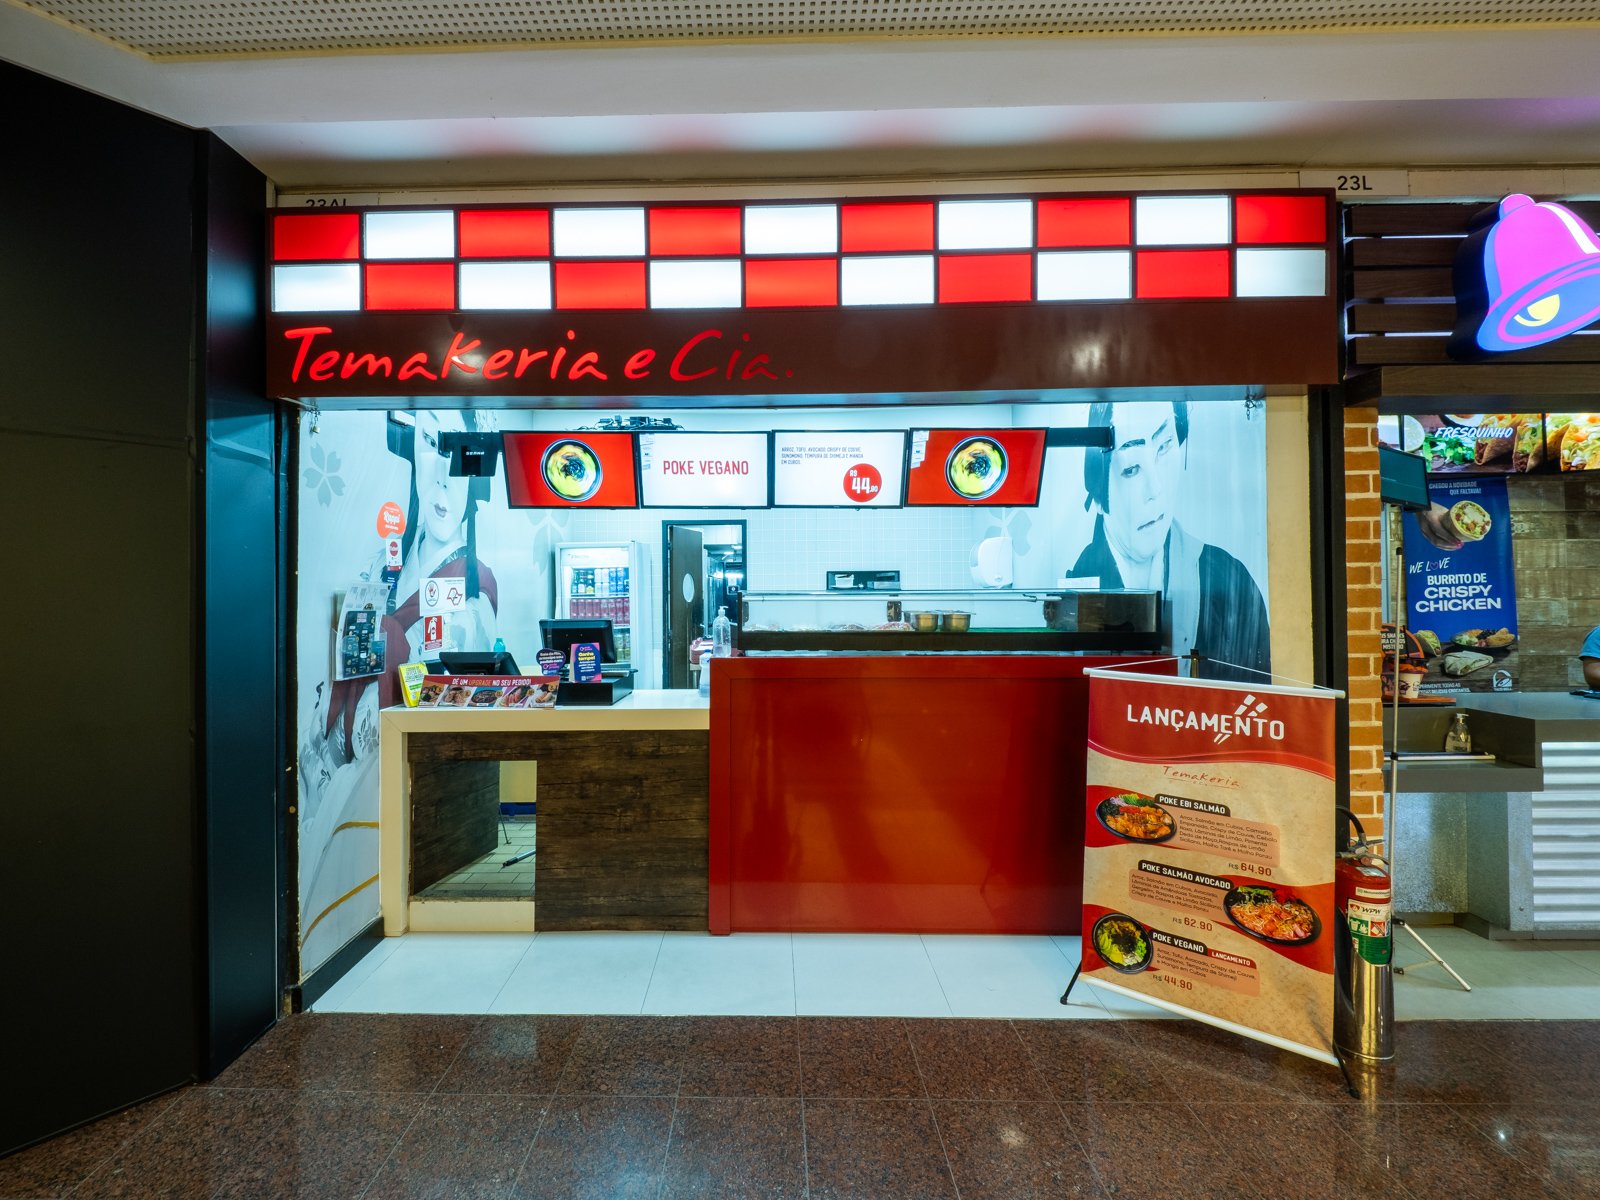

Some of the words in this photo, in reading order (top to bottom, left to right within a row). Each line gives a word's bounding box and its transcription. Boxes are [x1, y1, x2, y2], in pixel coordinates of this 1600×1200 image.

[1337, 175, 1373, 191] 23L
[624, 349, 656, 379] e
[669, 329, 793, 382] Cia.
[1434, 427, 1514, 438] FRESQUINHO
[663, 460, 695, 475] POKE
[699, 460, 749, 475] VEGANO
[1409, 562, 1424, 574] WE
[1427, 573, 1472, 586] BURRITO
[1473, 573, 1487, 584] DE
[1424, 585, 1493, 599] CRISPY
[1415, 597, 1502, 613] CHICKEN
[1127, 702, 1285, 741] LANÇAMENTO
[1159, 795, 1178, 806] POKE
[1180, 800, 1192, 809] EBI
[1193, 802, 1226, 815] SALMÃO
[1141, 863, 1160, 873] POKE
[1162, 867, 1194, 881] SALMÃO
[1195, 875, 1232, 890] AVOCADO
[1228, 862, 1239, 870] R$
[1240, 862, 1272, 877] 64.90
[1172, 916, 1182, 925] R$
[1183, 917, 1213, 932] 62.90
[1152, 932, 1172, 944] POKE
[1173, 938, 1204, 953] VEGANO
[1153, 973, 1162, 982] R$
[1164, 974, 1193, 991] 44.90
